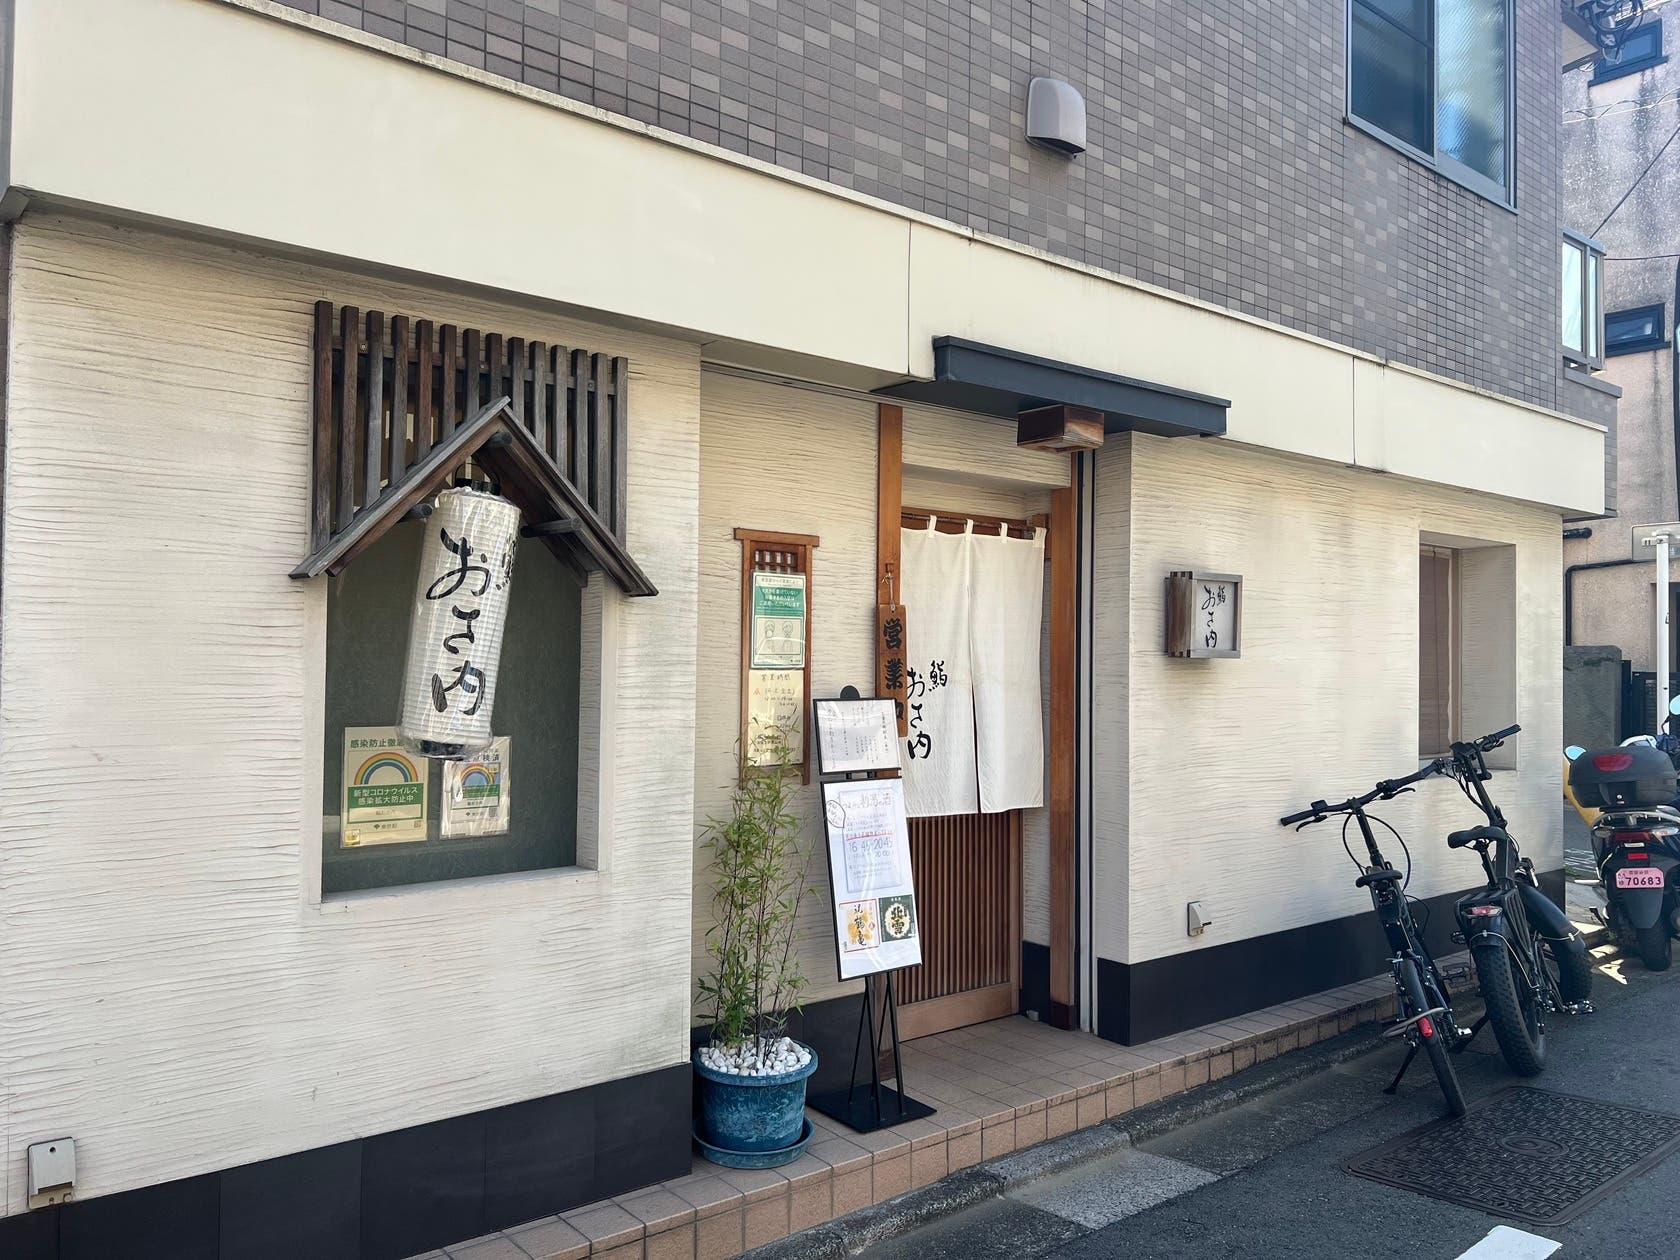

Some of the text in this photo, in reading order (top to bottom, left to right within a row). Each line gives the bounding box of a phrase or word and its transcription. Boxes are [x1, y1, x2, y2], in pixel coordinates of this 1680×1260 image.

[425, 527, 491, 717] おさ内
[1201, 585, 1217, 648] おさ内
[928, 660, 948, 692] 鮨
[907, 666, 932, 759] おさ内
[353, 786, 418, 797] 新型コロナウイルス
[358, 795, 414, 806] 感染拡大防止中
[1625, 876, 1661, 886] 70683
